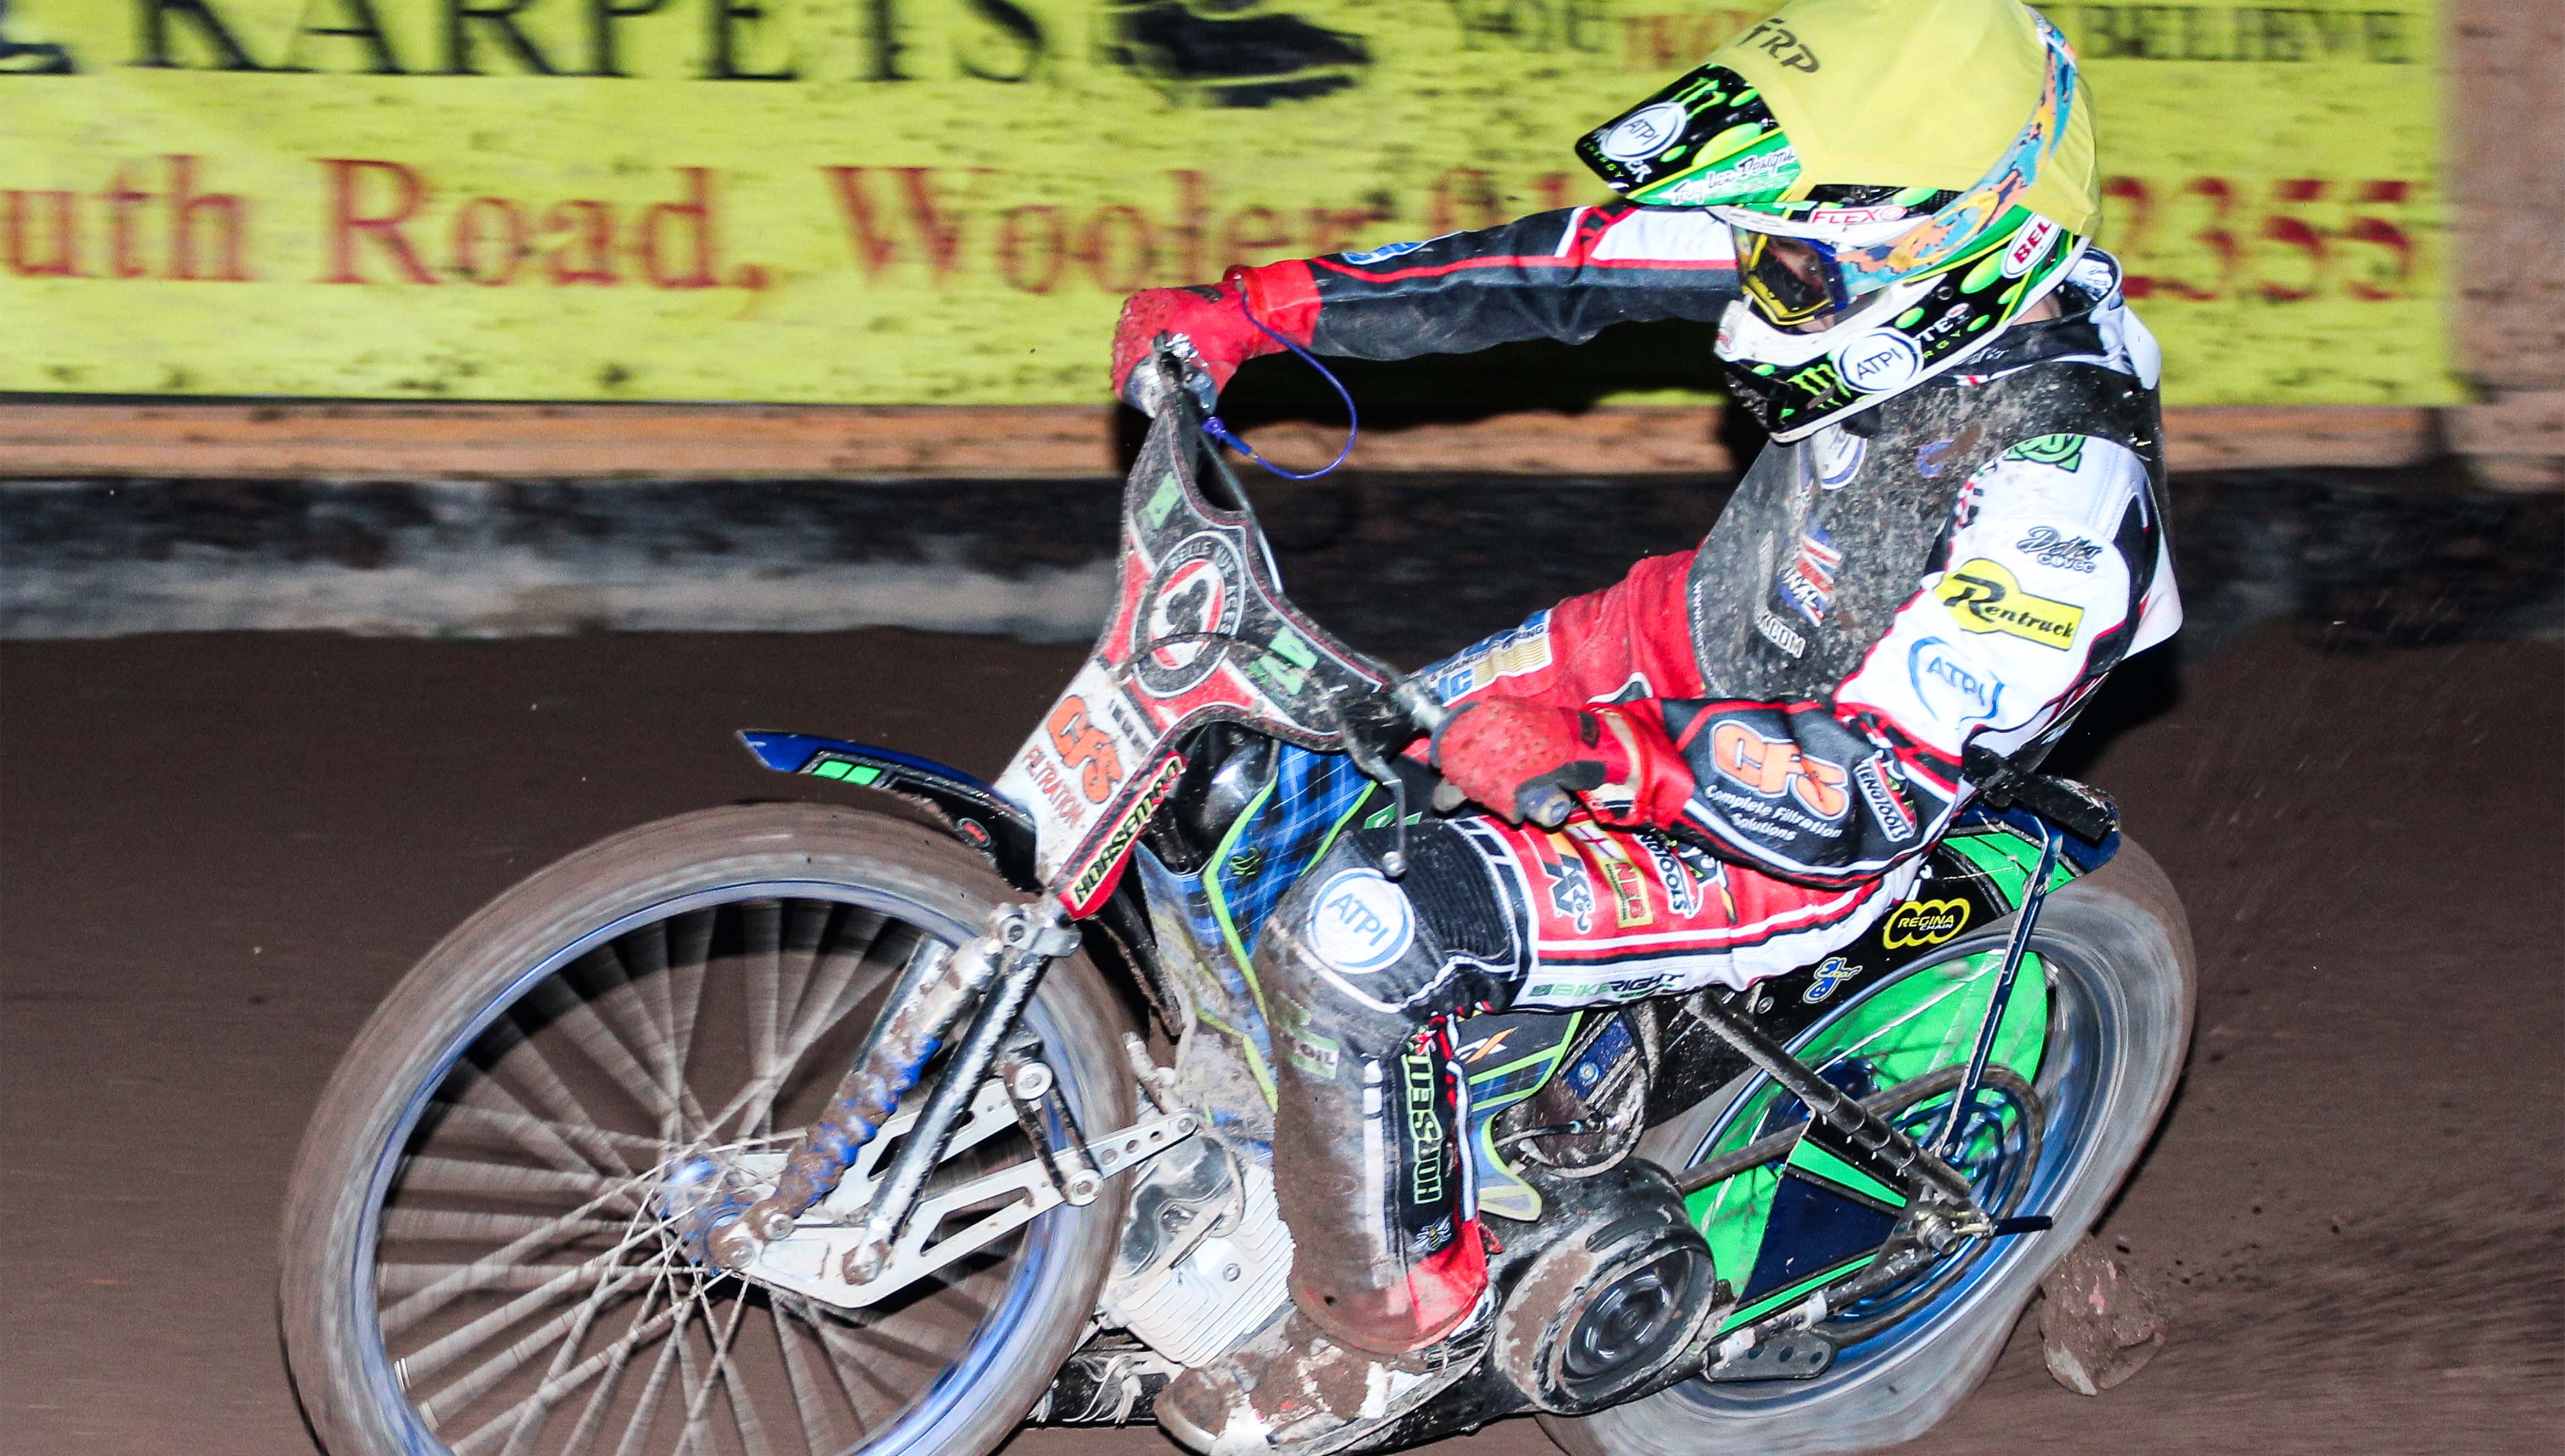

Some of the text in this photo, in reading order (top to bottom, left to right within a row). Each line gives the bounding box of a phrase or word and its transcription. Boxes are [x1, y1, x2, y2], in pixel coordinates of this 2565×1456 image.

[1624, 118, 1660, 145] ATPI
[314, 158, 772, 321] Road,
[1856, 347, 1905, 380] ATPI
[1943, 573, 2076, 639] Rentruck
[1927, 656, 1985, 706] ATPI
[1704, 784, 1843, 839] Complete Filtration
[1731, 813, 1798, 842] Solutions
[1326, 893, 1390, 947] ATPI
[1897, 915, 1954, 928] REGINA
[1919, 923, 1953, 931] CHAIN
